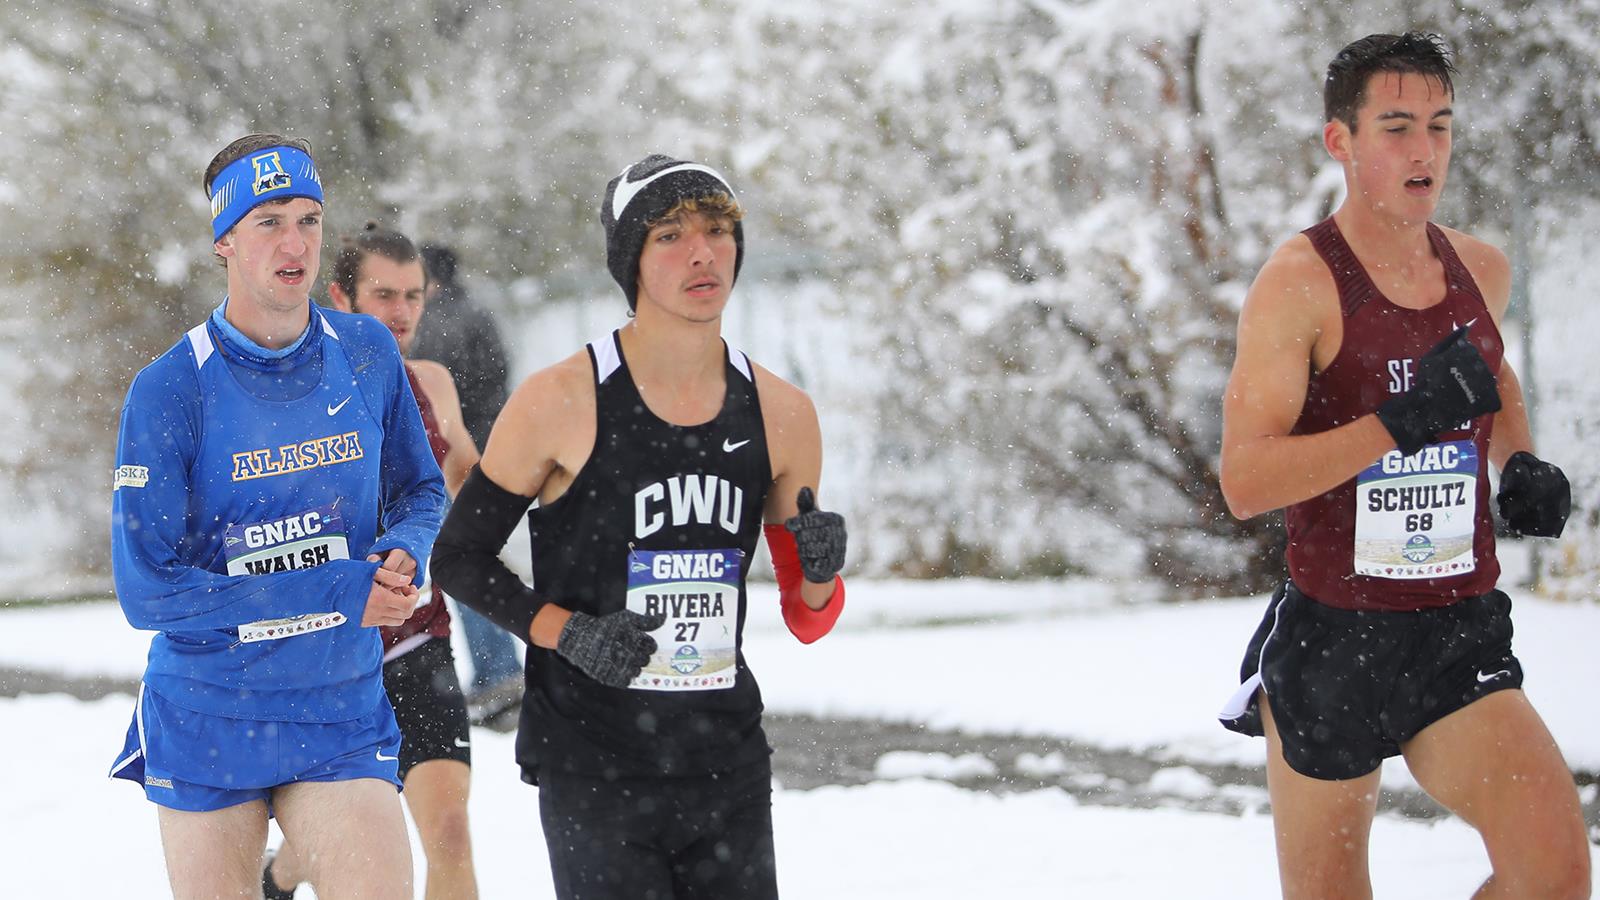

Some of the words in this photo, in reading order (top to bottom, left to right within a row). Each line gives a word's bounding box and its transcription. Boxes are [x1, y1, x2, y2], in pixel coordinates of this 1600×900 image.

[231, 432, 364, 481] ALASKA
[1382, 444, 1458, 474] GNAC
[635, 473, 743, 540] CWU
[1368, 481, 1466, 512] SCHULTZ
[244, 511, 322, 549] GNAC
[1405, 513, 1433, 532] 68
[245, 543, 330, 576] WALSH
[652, 552, 725, 579] GNAC
[645, 592, 724, 618] RIVERA
[674, 622, 700, 642] 27
